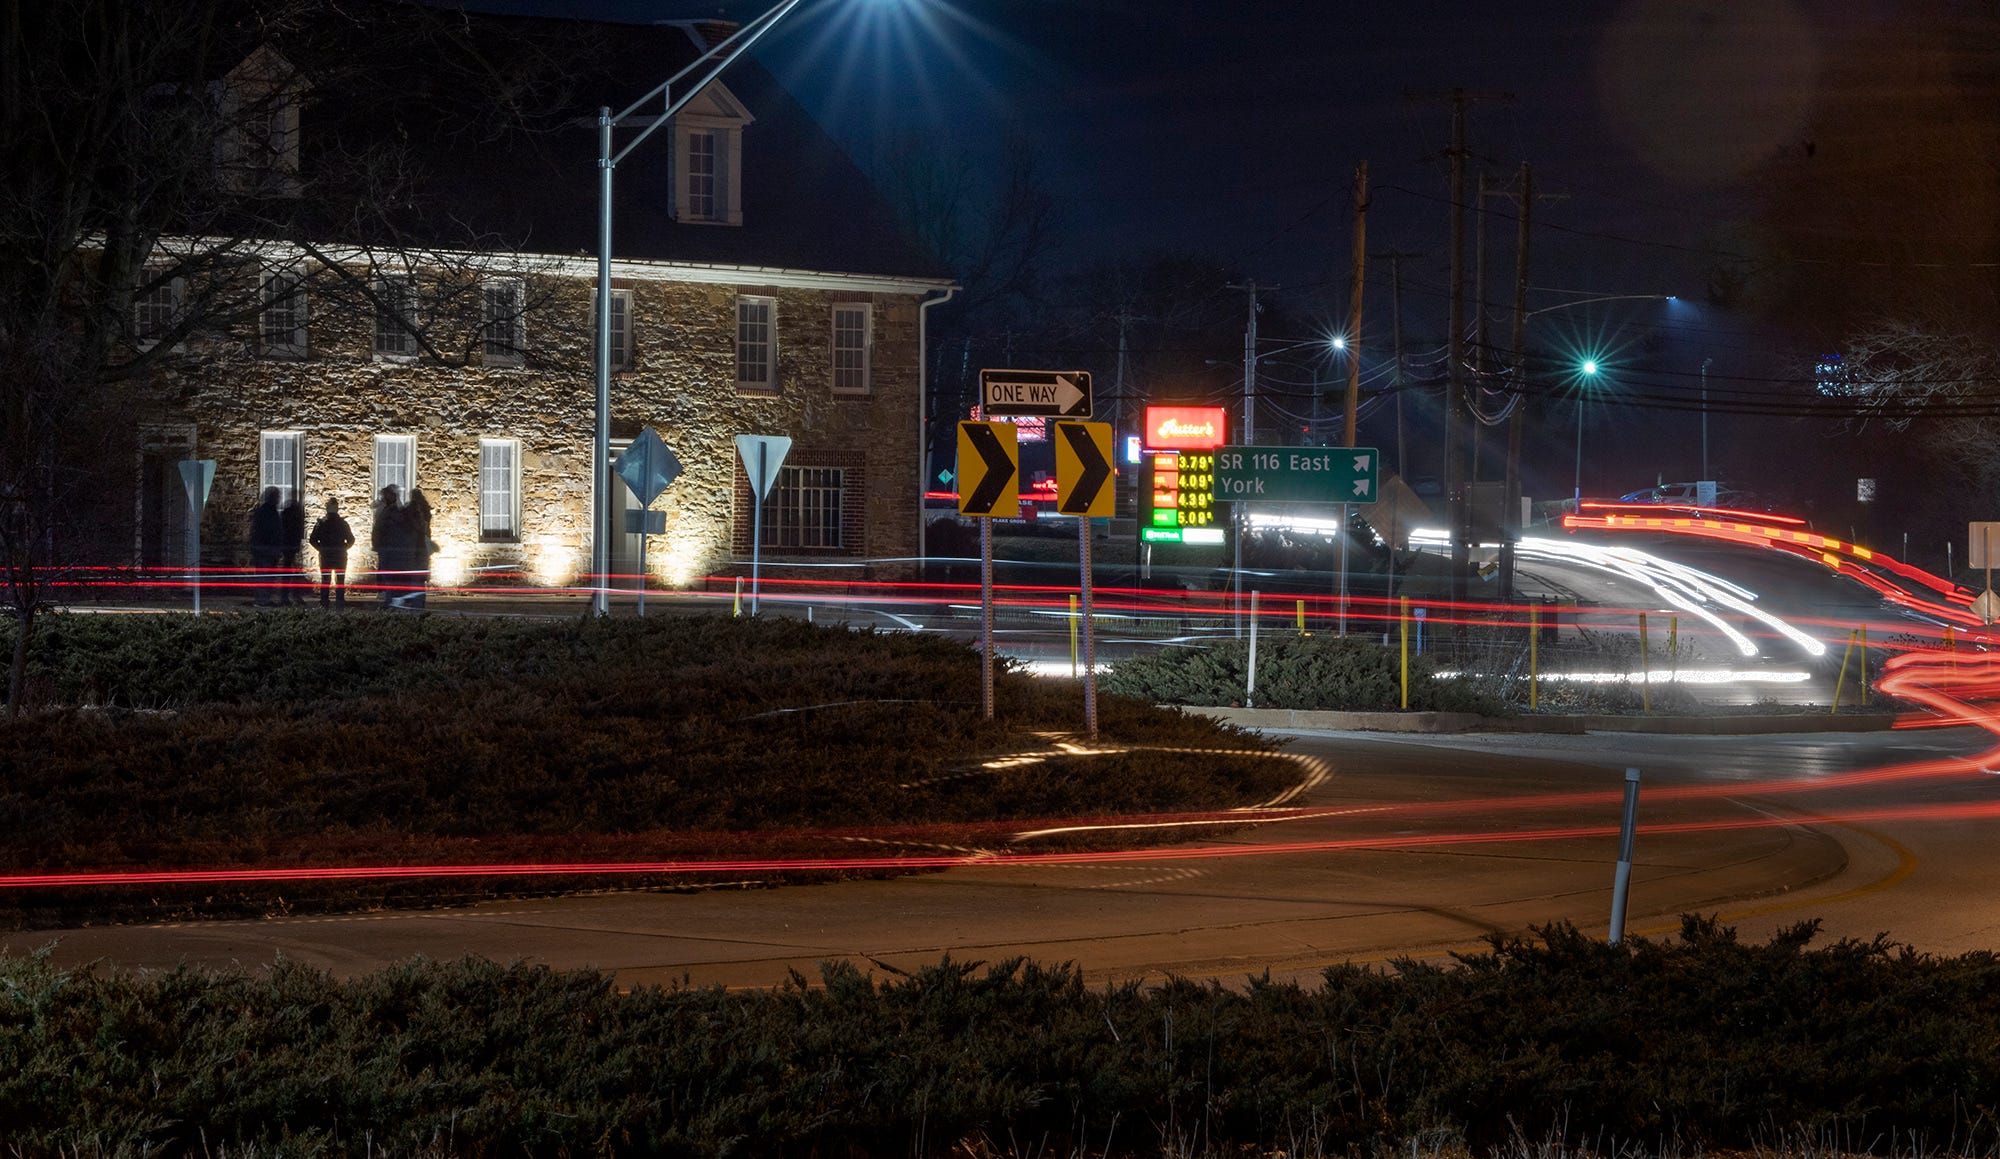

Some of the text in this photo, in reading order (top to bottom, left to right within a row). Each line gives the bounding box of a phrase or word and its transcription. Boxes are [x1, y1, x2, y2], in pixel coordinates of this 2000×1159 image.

[992, 384, 1057, 403] ONE WAY
[1220, 453, 1330, 471] SR 116 East
[1221, 477, 1265, 494] York
